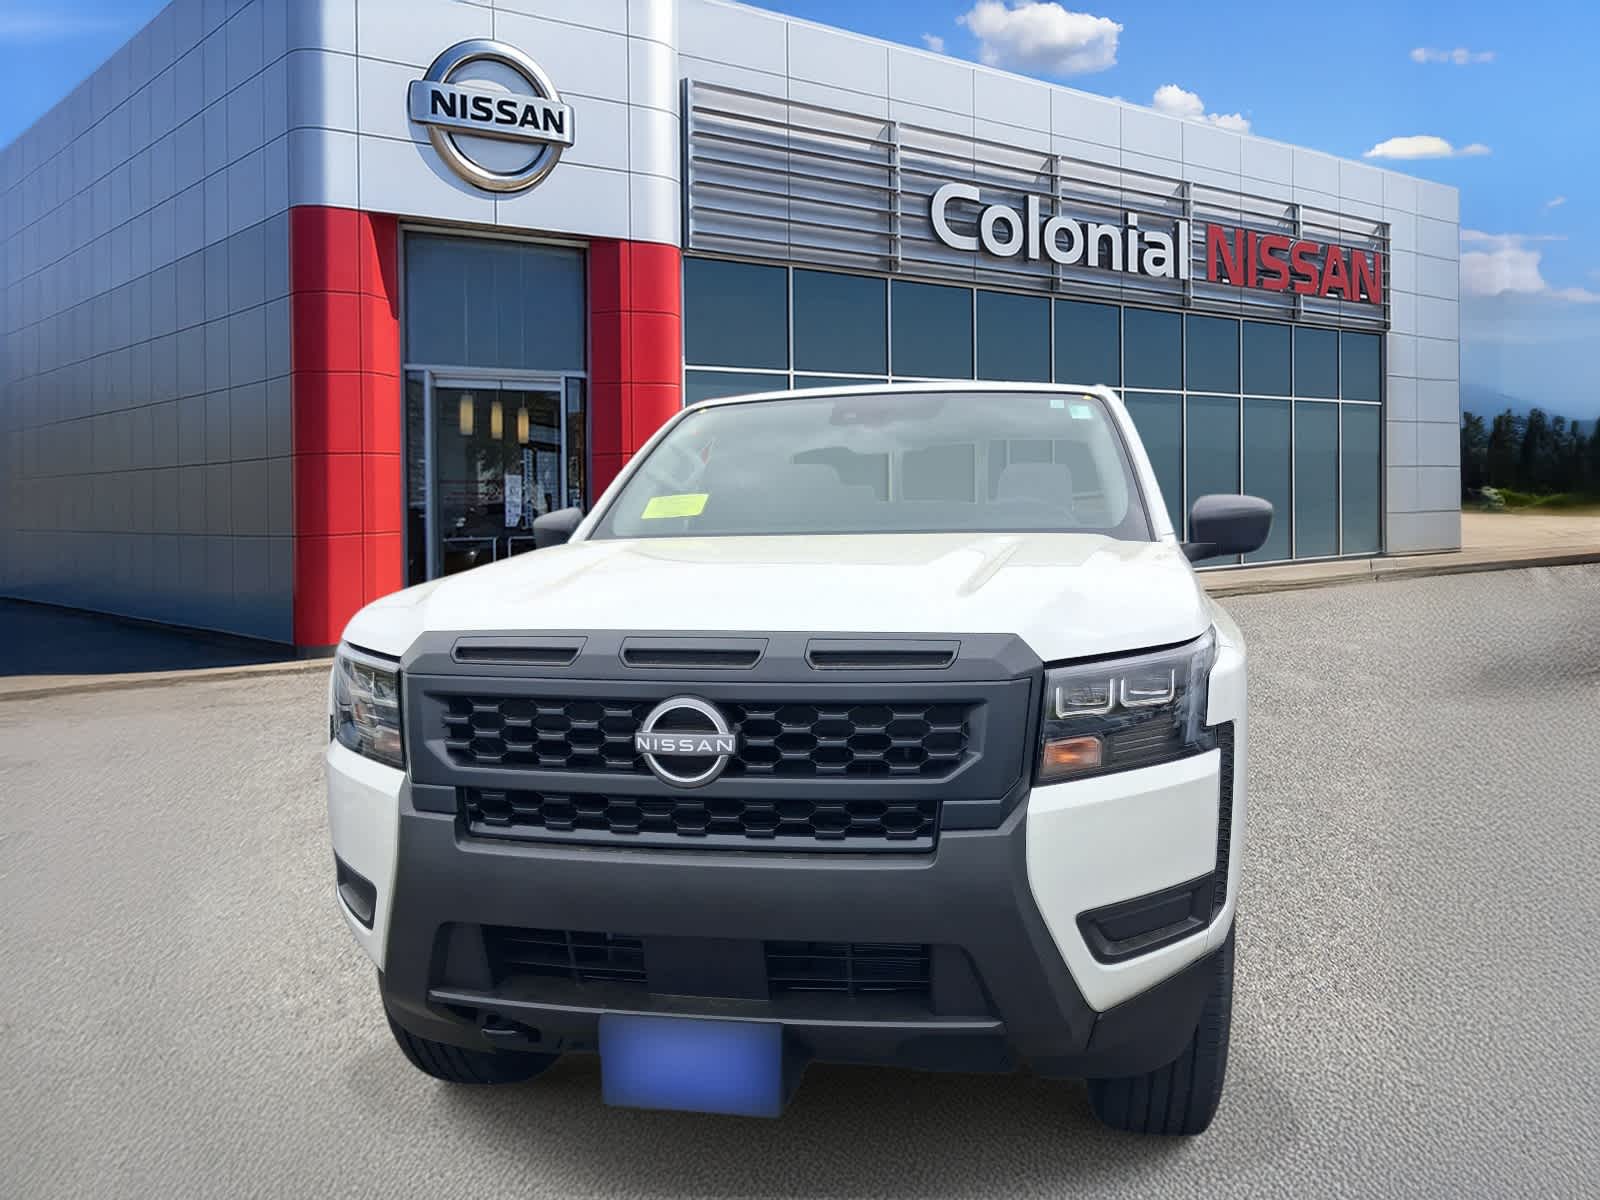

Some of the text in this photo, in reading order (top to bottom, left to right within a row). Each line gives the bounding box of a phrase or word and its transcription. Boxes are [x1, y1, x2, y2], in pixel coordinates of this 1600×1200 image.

[430, 89, 565, 135] NISSAN
[930, 182, 1382, 305] Colonial NISSAN
[637, 736, 733, 753] NISSAN
